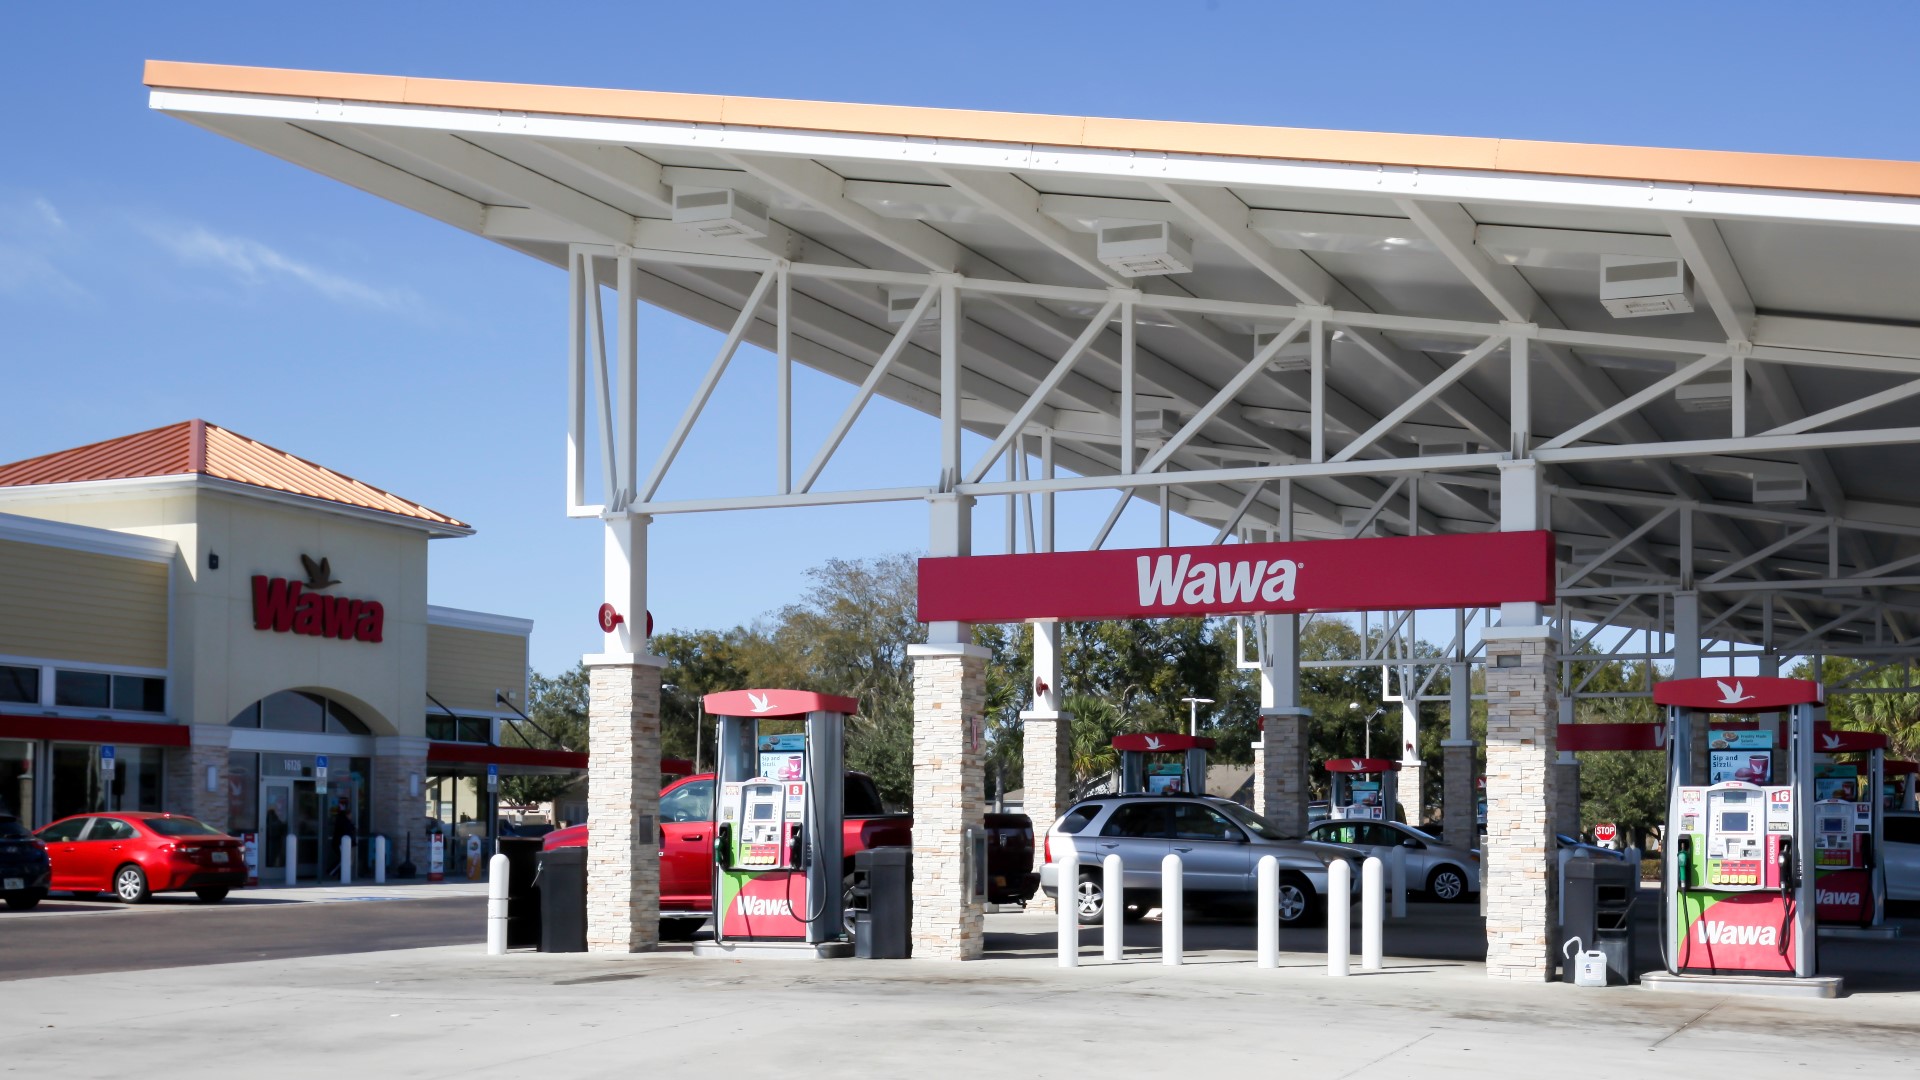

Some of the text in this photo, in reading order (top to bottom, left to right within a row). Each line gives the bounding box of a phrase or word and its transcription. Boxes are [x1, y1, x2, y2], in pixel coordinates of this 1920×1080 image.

[1137, 554, 1297, 607] Wawa
[251, 575, 384, 643] Wawa
[604, 609, 612, 627] 8
[792, 785, 799, 795] 8
[1775, 791, 1789, 801] 16
[1596, 827, 1615, 835] STOP
[736, 895, 793, 916] Wawa
[1697, 920, 1777, 946] Wawa
